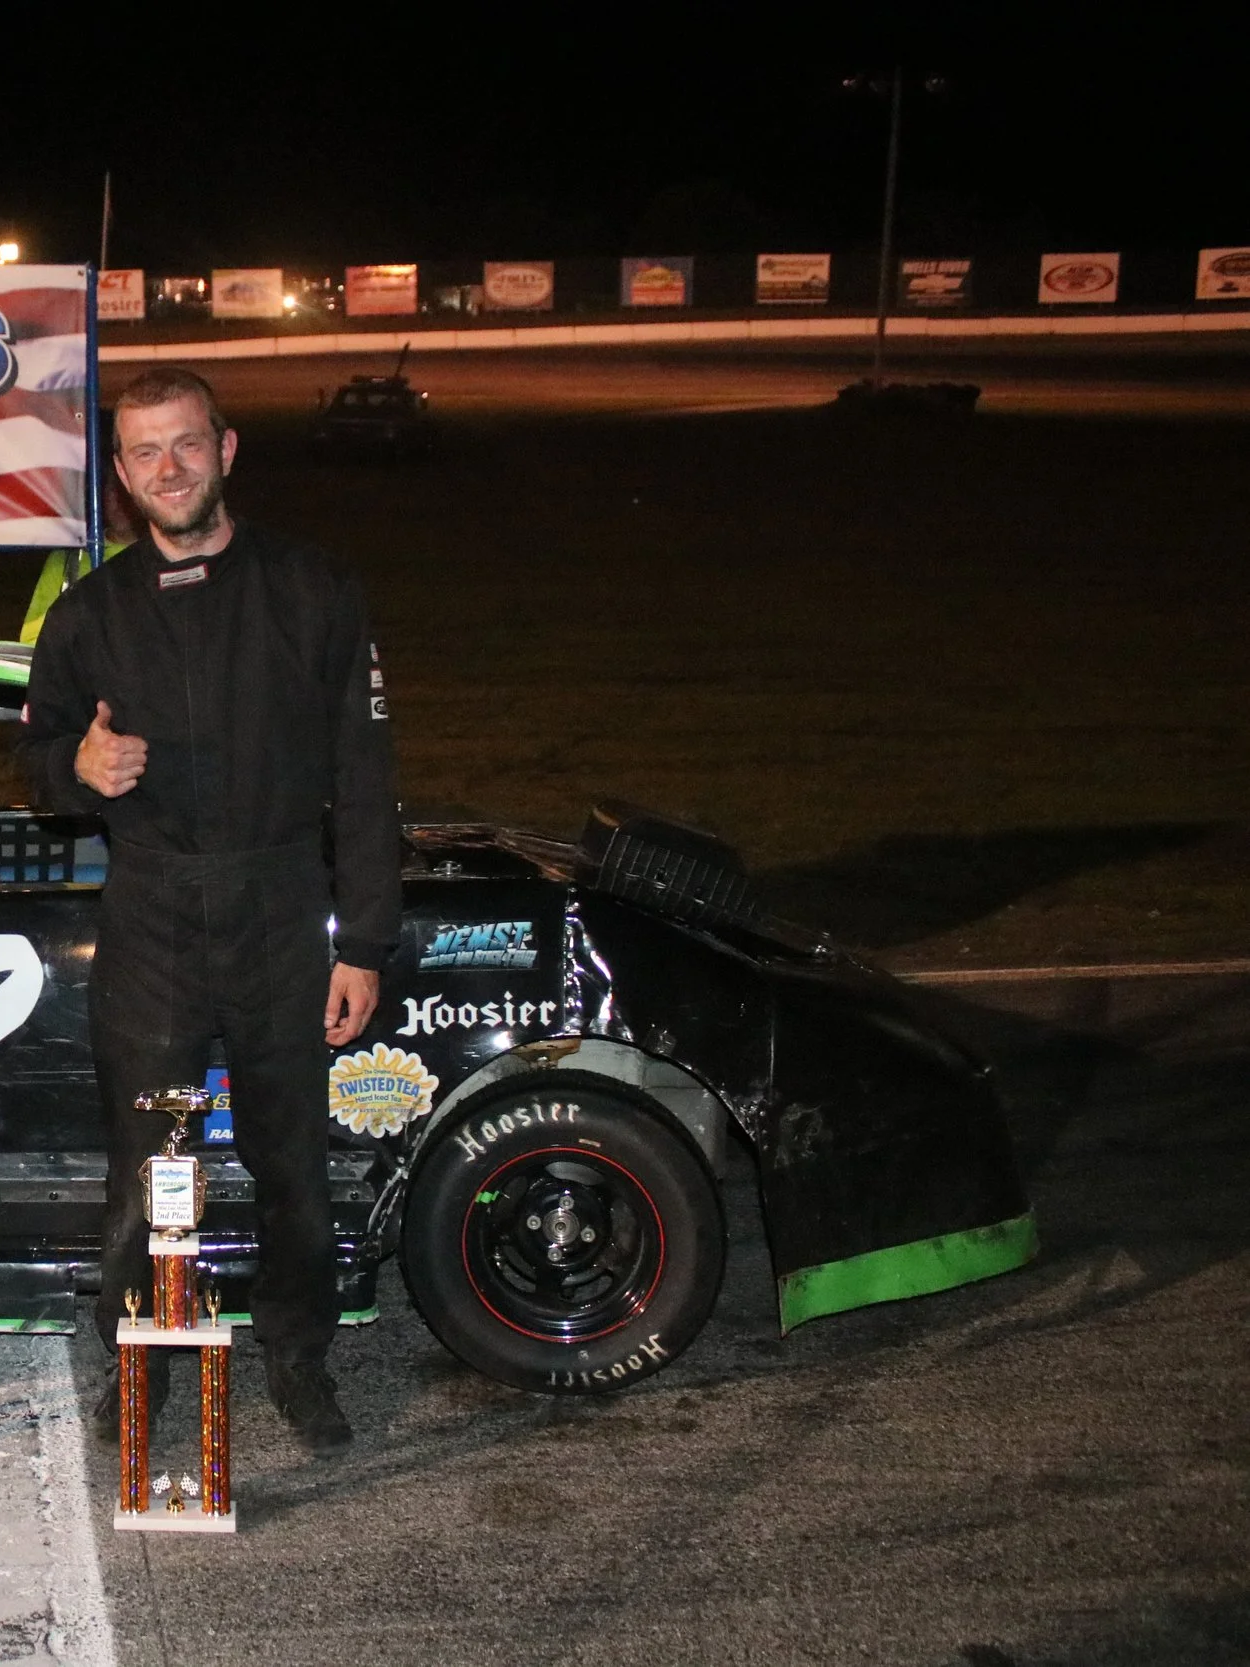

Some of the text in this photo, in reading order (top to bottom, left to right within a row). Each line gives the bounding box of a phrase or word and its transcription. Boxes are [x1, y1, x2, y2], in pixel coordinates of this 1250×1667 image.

[430, 922, 532, 956] NEMST
[396, 991, 556, 1036] Hoosier
[336, 1077, 420, 1098] TWISTED TEA
[355, 1093, 402, 1103] Hard Iced Tea
[454, 1096, 581, 1163] Hoosier
[156, 1211, 191, 1220] 2nd Place
